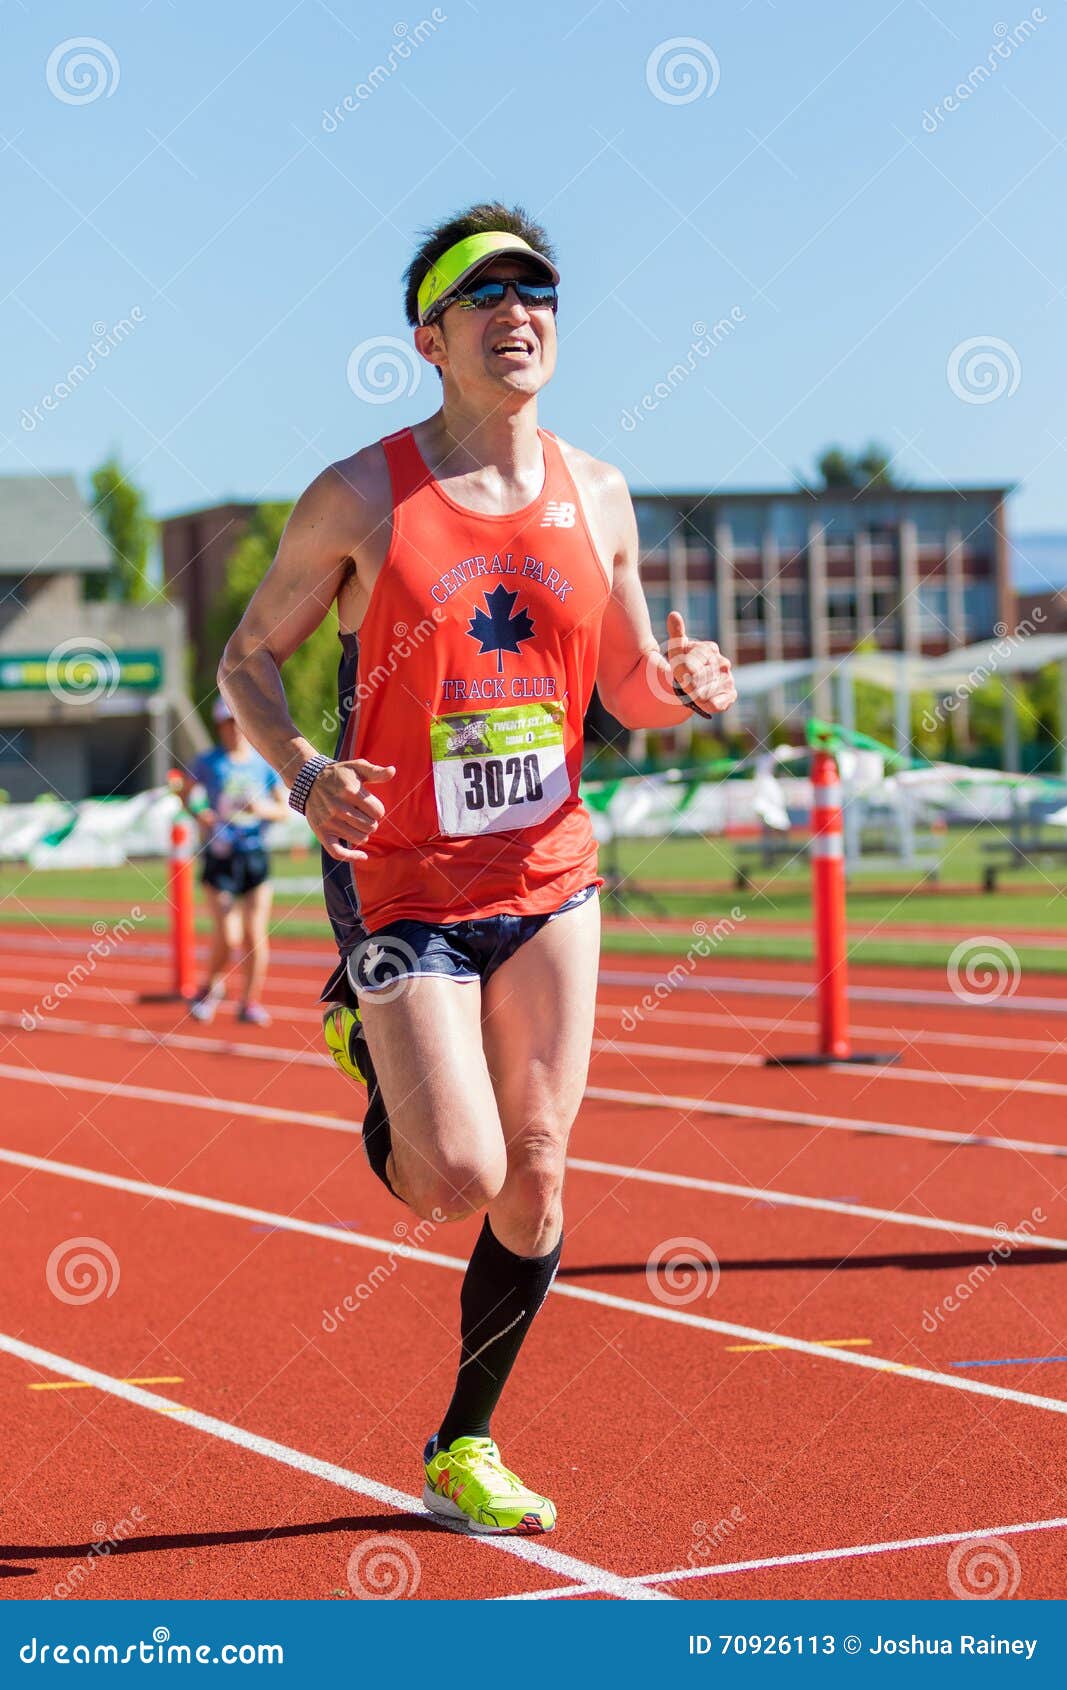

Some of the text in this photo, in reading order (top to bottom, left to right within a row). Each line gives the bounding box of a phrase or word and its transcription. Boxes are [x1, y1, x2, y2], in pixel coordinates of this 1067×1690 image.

[430, 553, 574, 605] CENTRAL PARK
[441, 677, 556, 700] TRACK CLUB
[462, 753, 544, 811] 3020
